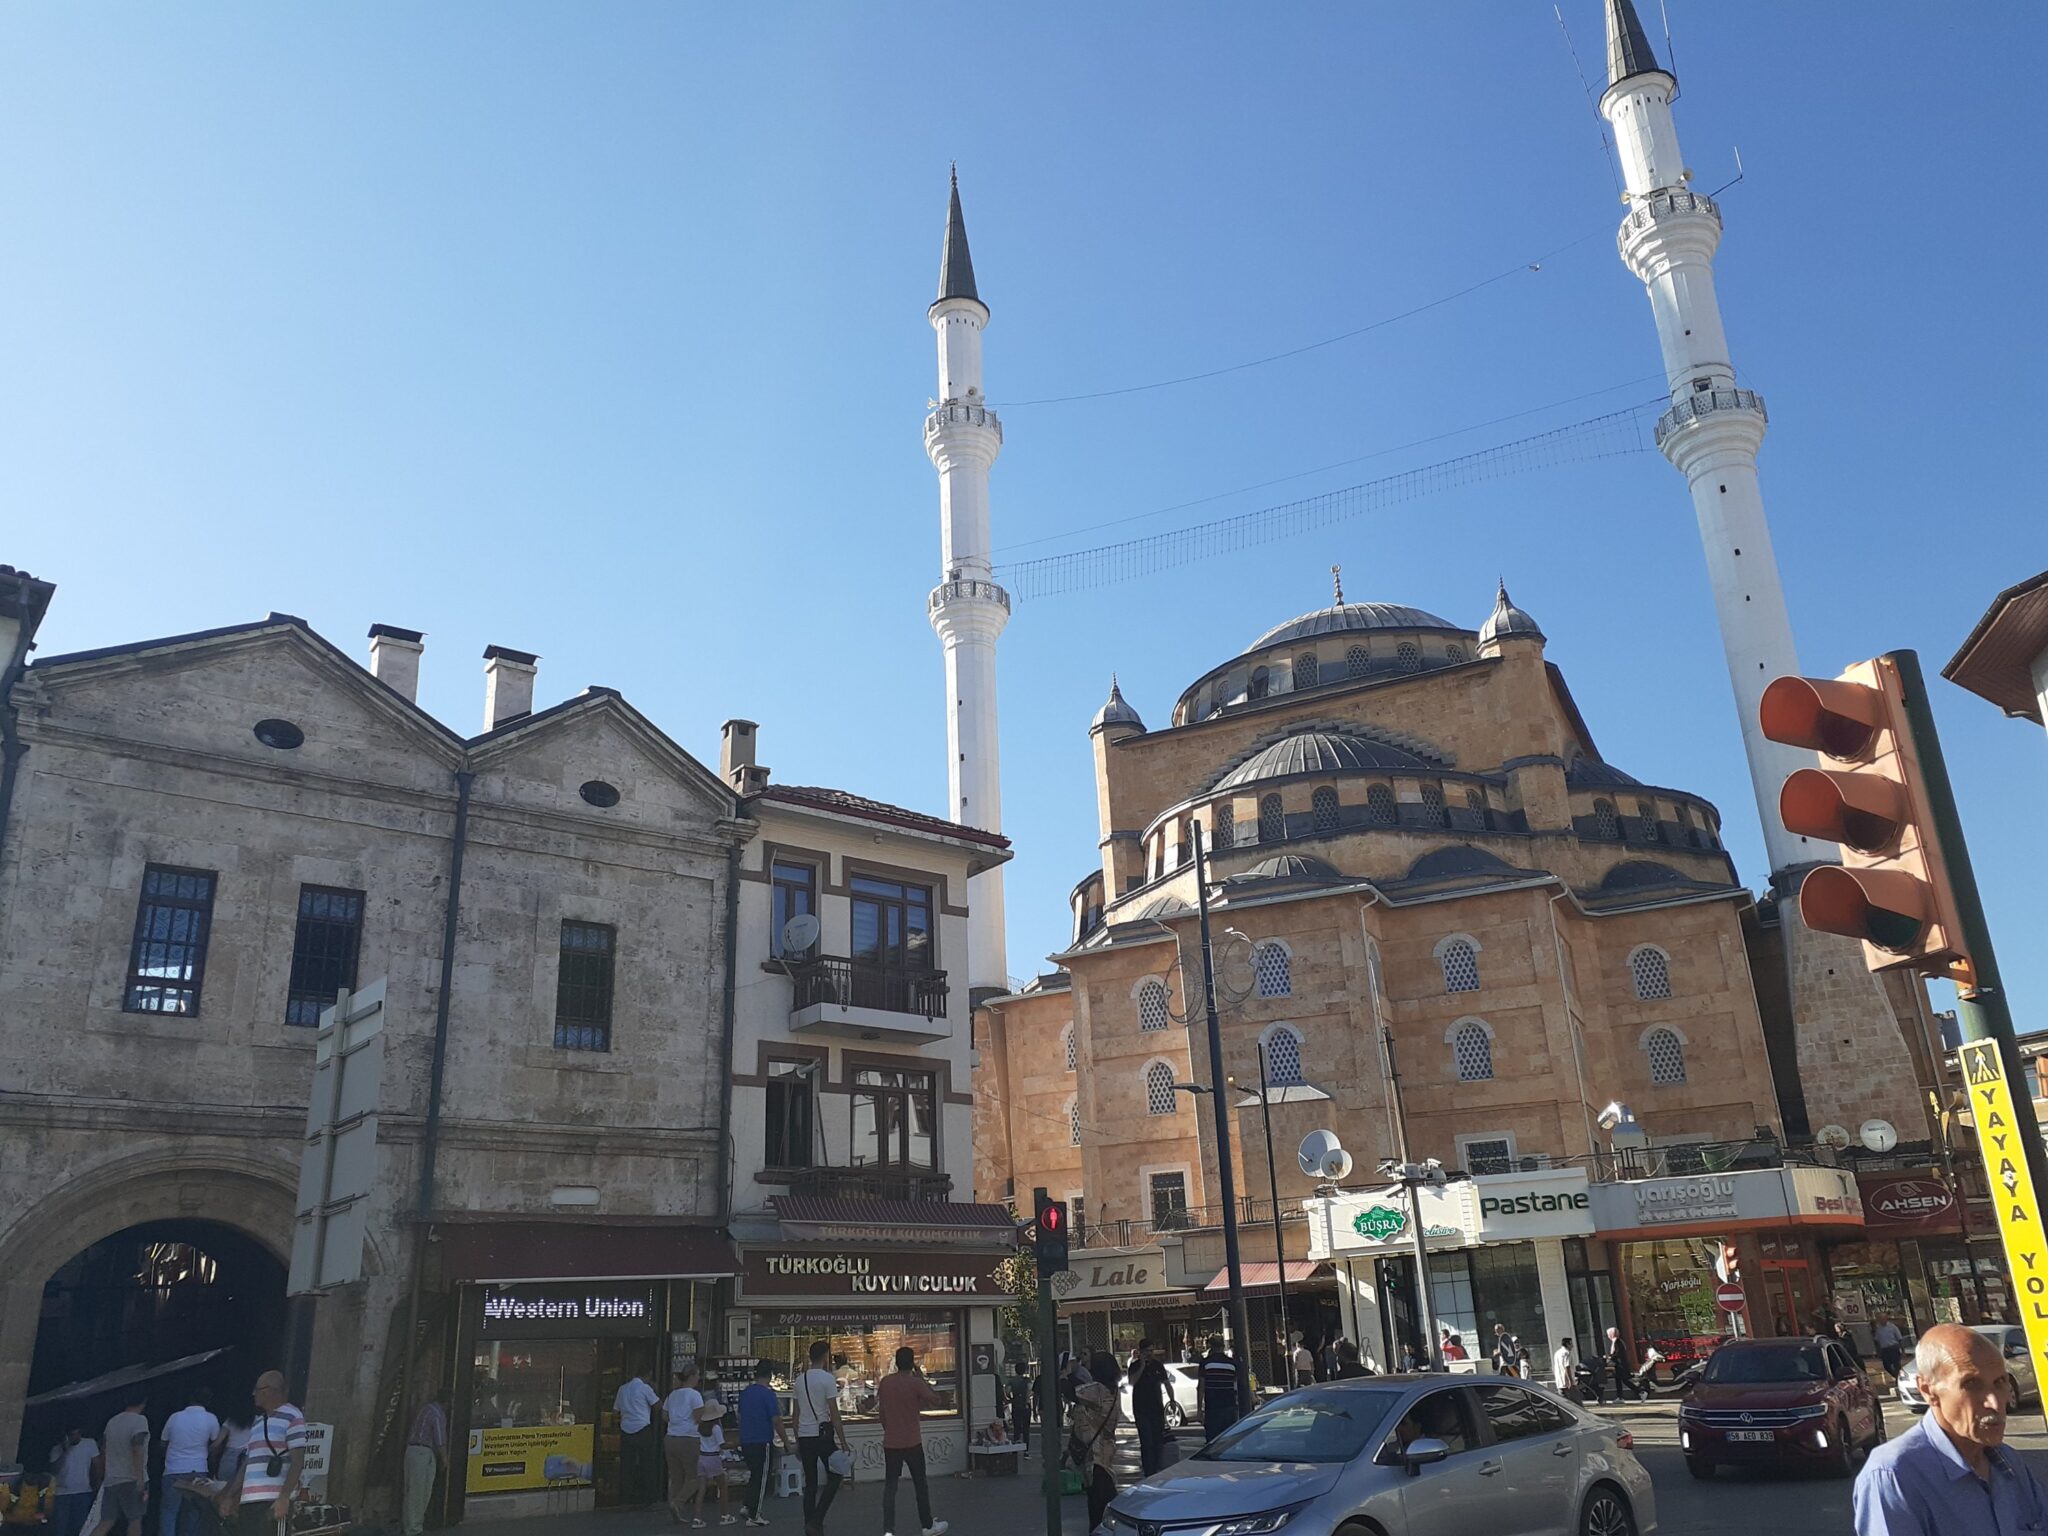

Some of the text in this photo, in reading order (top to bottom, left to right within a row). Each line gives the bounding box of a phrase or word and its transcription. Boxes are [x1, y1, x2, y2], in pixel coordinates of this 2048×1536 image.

[1980, 1087, 2029, 1222] YAYAYA
[1634, 1177, 1735, 1207] yarışoğlu
[1481, 1191, 1590, 1218] Pastane
[1880, 1195, 1947, 1211] AHSEN
[819, 1226, 981, 1240] TÜRKOĞLU KUYUMCULUK
[1360, 1219, 1399, 1233] BÜŞRA
[766, 1253, 870, 1274] TÜRKOĞLU
[852, 1275, 977, 1292] KUYUMCULUK
[1090, 1264, 1148, 1288] Lale
[486, 1298, 644, 1319] Western Union
[304, 1430, 325, 1443] ŞHAN
[304, 1457, 323, 1470] FÖRÜ
